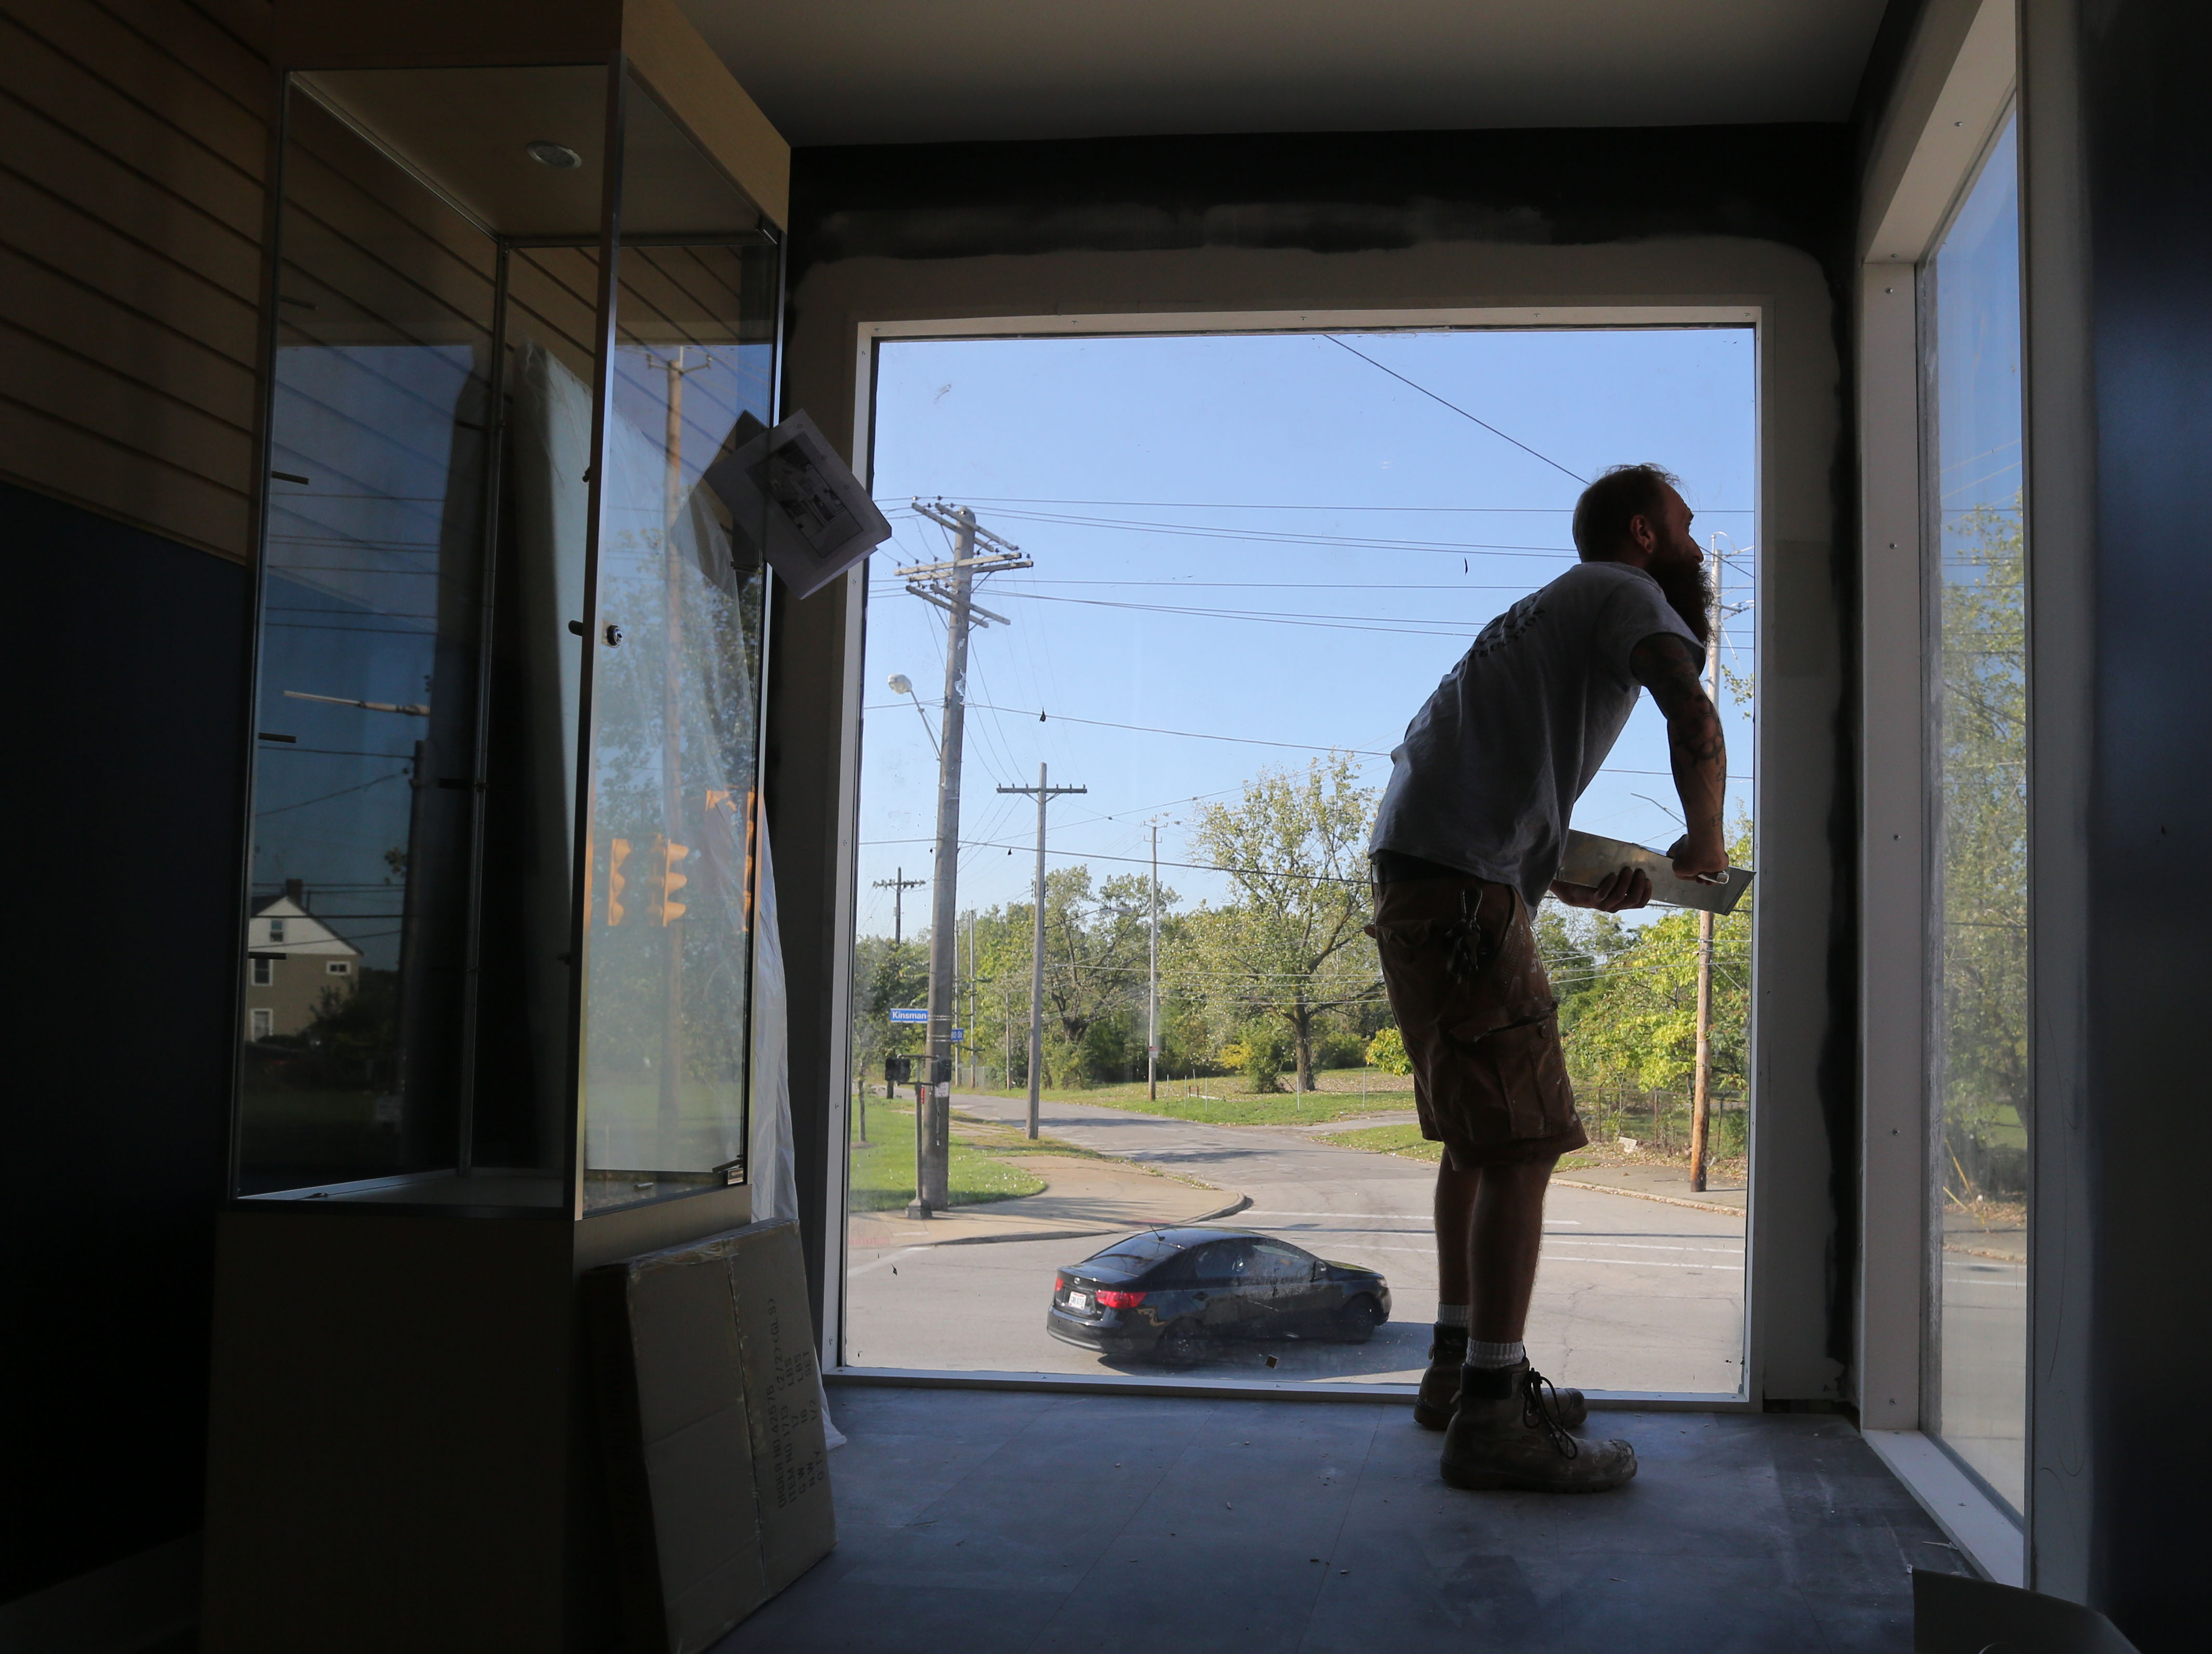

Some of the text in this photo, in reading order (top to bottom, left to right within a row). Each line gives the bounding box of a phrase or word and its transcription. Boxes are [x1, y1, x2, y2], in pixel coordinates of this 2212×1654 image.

[892, 1011, 927, 1020] Kinsman
[785, 1357, 794, 1386] LBS
[794, 1354, 803, 1382] LBS
[803, 1351, 812, 1377] SET
[781, 1405, 789, 1437] 1713
[774, 1462, 786, 1508] ORDER
[787, 1467, 797, 1503] ITEM
